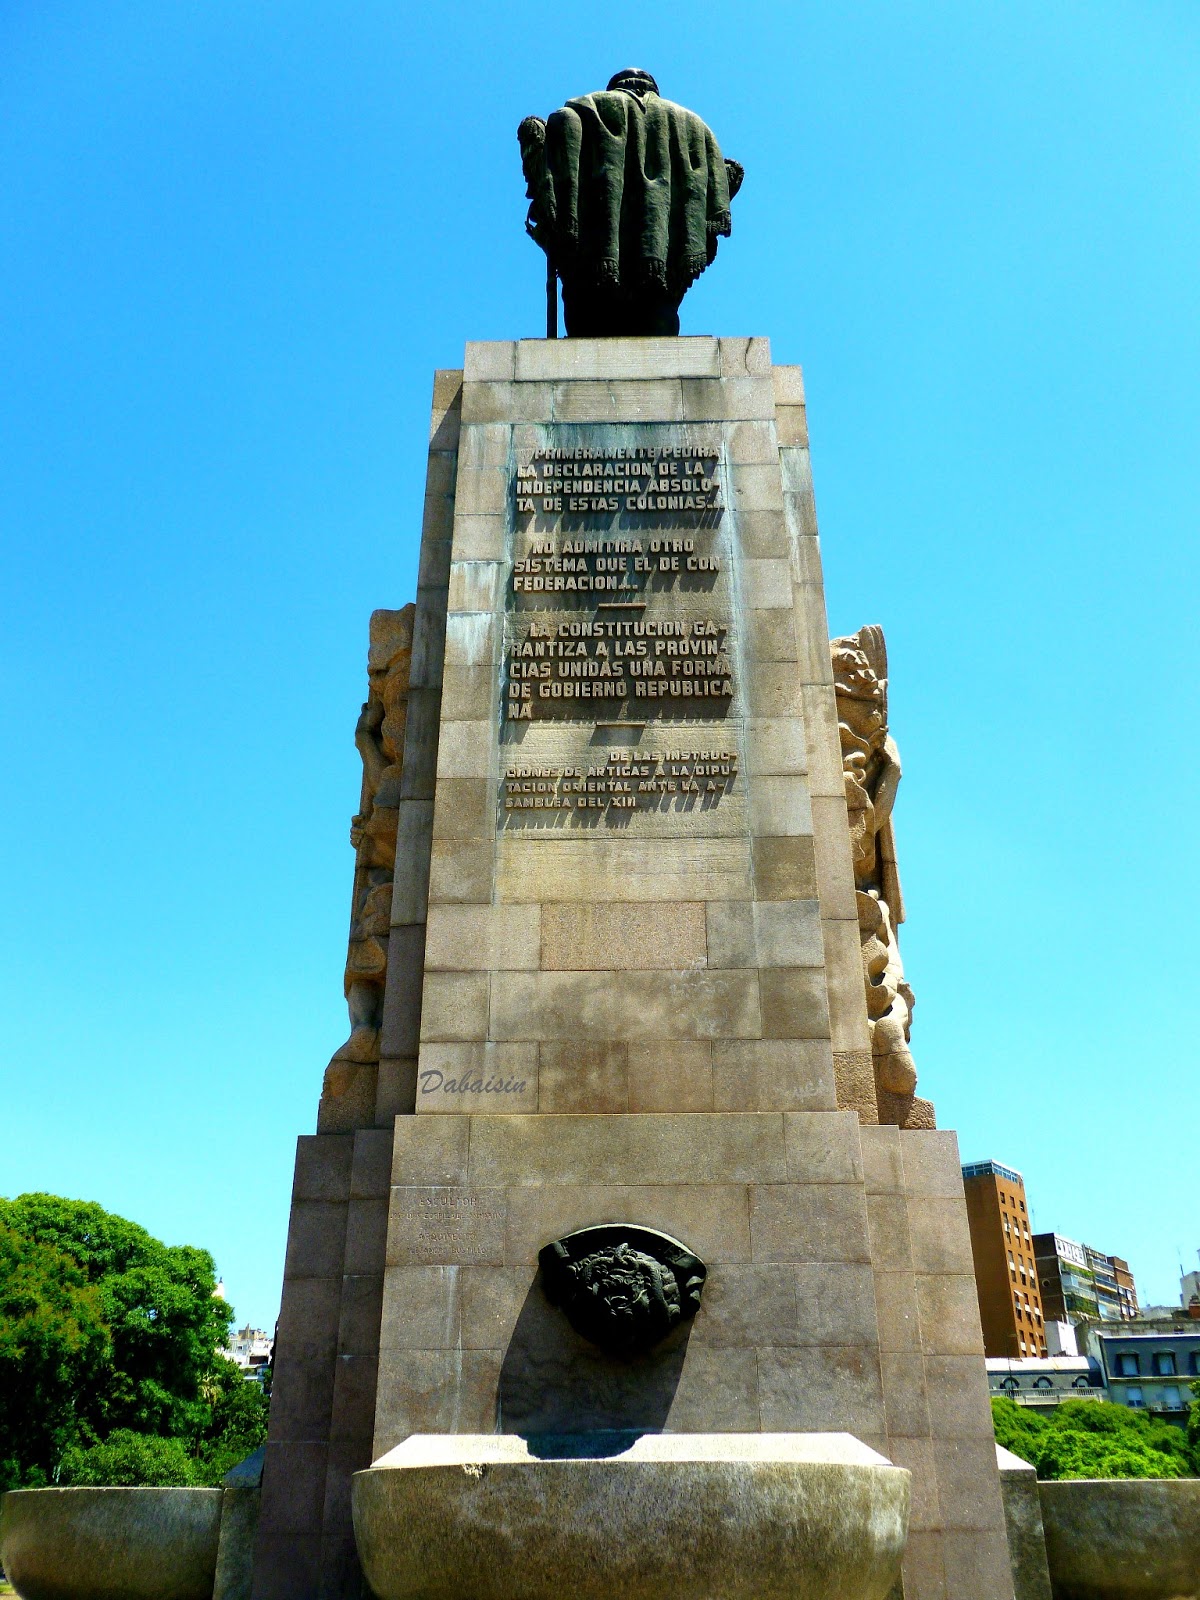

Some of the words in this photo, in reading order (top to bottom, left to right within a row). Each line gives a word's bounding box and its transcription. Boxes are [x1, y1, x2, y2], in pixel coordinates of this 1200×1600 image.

[534, 447, 656, 460] PRIMERAMENTE
[662, 447, 720, 458] PEDIRA
[517, 465, 537, 478] LA
[543, 464, 652, 476] DECLARACION
[659, 463, 677, 475] DE
[685, 462, 704, 475] LA
[517, 480, 641, 495] INDEPENDENCIA
[517, 498, 535, 512] TA
[543, 498, 562, 511] DE
[570, 497, 619, 511] ESTAS
[533, 541, 553, 554] NO
[563, 540, 642, 553] ADMITIRA
[650, 539, 694, 553] OTRO
[515, 559, 587, 573] SISTEMA
[596, 558, 626, 571] QUE
[635, 558, 652, 571] EL
[659, 557, 679, 571] DE
[531, 624, 547, 638] LA
[559, 622, 685, 636] CONSTITUCION
[511, 641, 587, 657] RANTIZA
[595, 642, 608, 656] A
[615, 641, 647, 655] LAS
[510, 662, 551, 678] CIAS
[559, 662, 623, 677] UNIDAS
[630, 661, 666, 676] UNA
[672, 661, 731, 676] FORMA
[509, 683, 531, 698] DE
[540, 682, 627, 697] GOBIERNO
[509, 703, 531, 719] NA
[610, 753, 630, 762] DE
[634, 752, 660, 762] LAS
[506, 767, 563, 778] CIONES
[565, 767, 583, 777] DE
[587, 766, 649, 776] ARTIGAS
[655, 765, 666, 776] A
[671, 766, 690, 776] LA
[506, 782, 556, 793] TACION
[563, 782, 631, 792] ORIENTAL
[638, 781, 675, 792] ANTE
[506, 797, 571, 808] SAMBLEA
[578, 797, 605, 808] DEL
